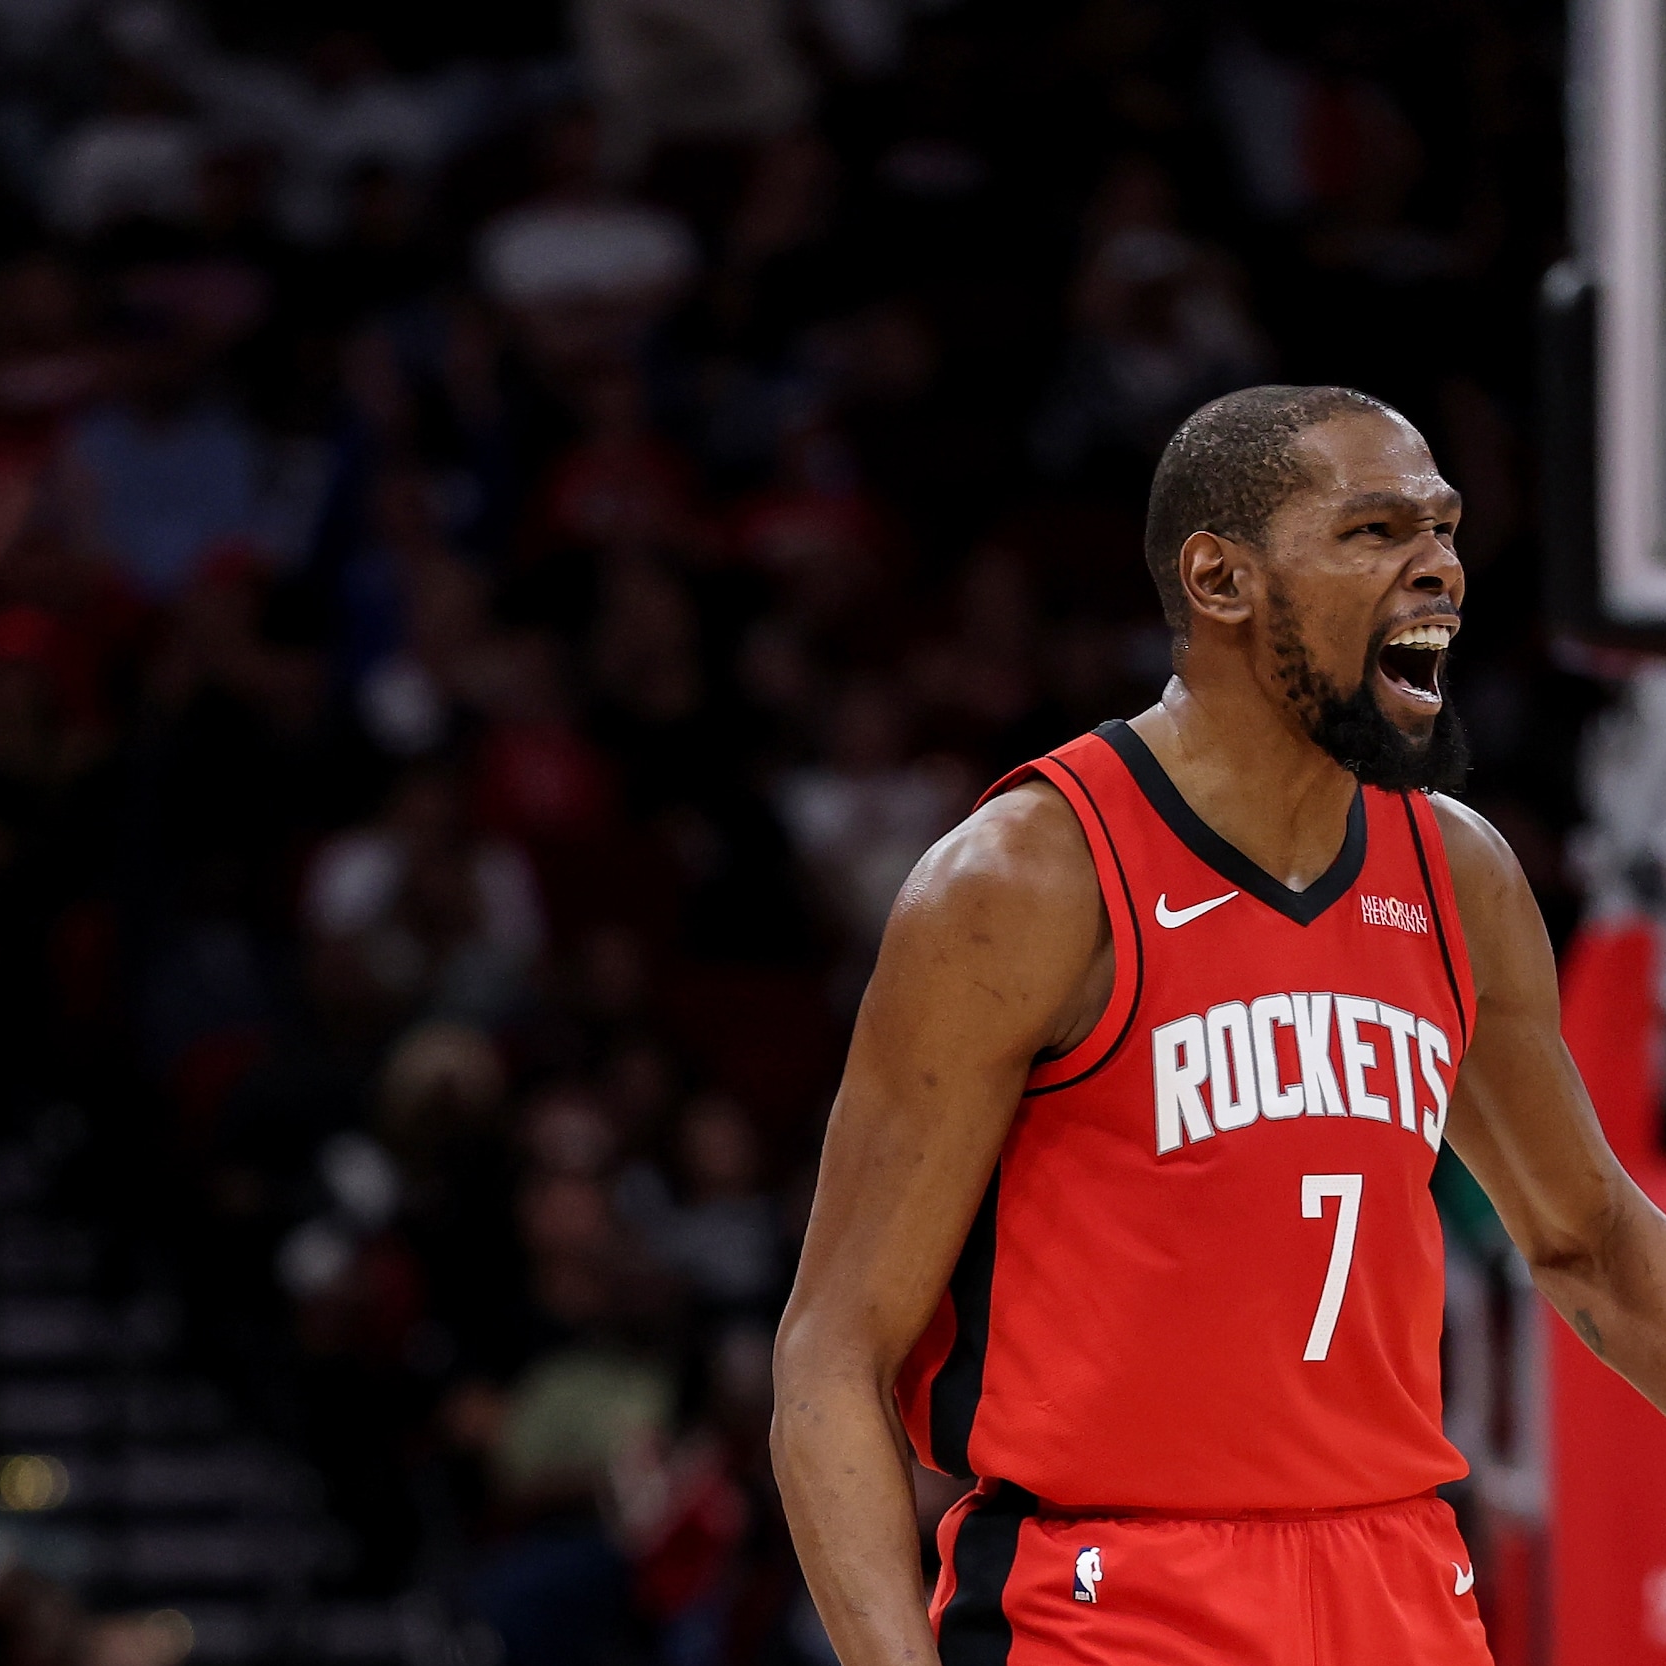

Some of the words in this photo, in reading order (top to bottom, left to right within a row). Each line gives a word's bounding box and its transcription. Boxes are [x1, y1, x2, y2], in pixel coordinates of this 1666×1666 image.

[1360, 894, 1427, 921] MEMORIAL
[1362, 908, 1428, 934] HERMANN
[1152, 992, 1452, 1156] ROCKETS
[1301, 1174, 1364, 1361] 7
